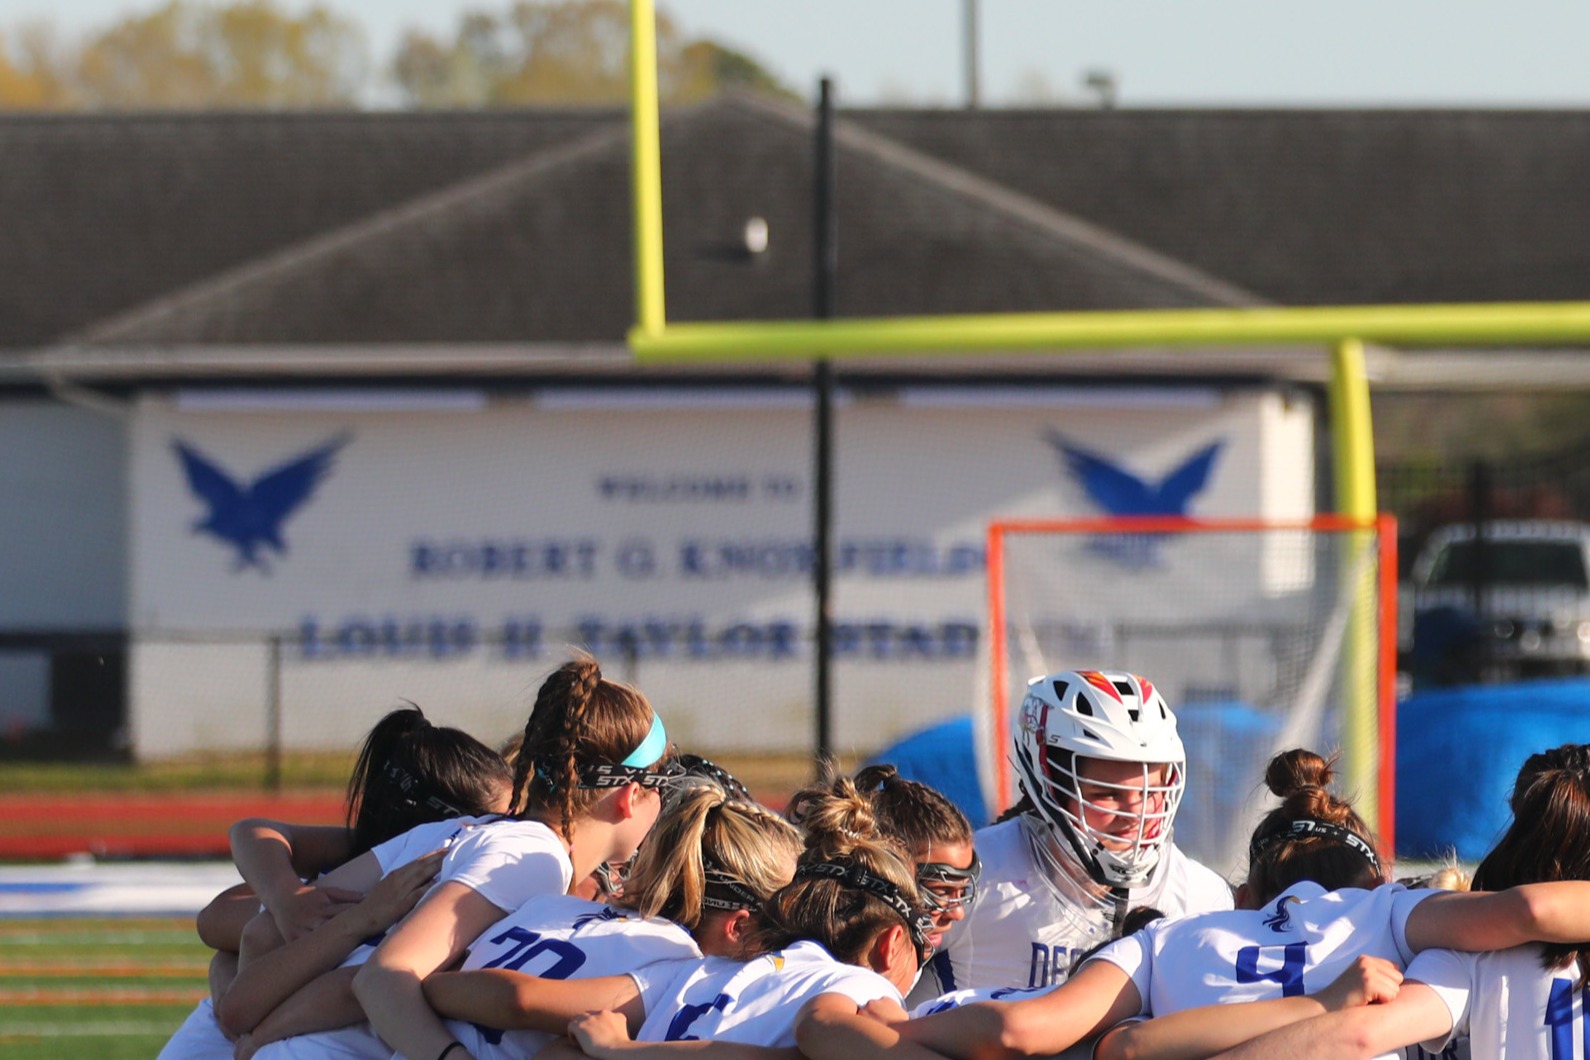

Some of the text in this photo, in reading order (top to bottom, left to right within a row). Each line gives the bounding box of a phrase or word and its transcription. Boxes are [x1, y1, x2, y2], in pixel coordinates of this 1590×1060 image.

[411, 539, 598, 580] ROBERT
[299, 612, 478, 660] LOUIS
[575, 613, 798, 660] TAYLOR
[831, 614, 983, 660] STAD
[596, 775, 634, 787] STX
[1345, 833, 1375, 863] STX
[1235, 940, 1309, 998] 4
